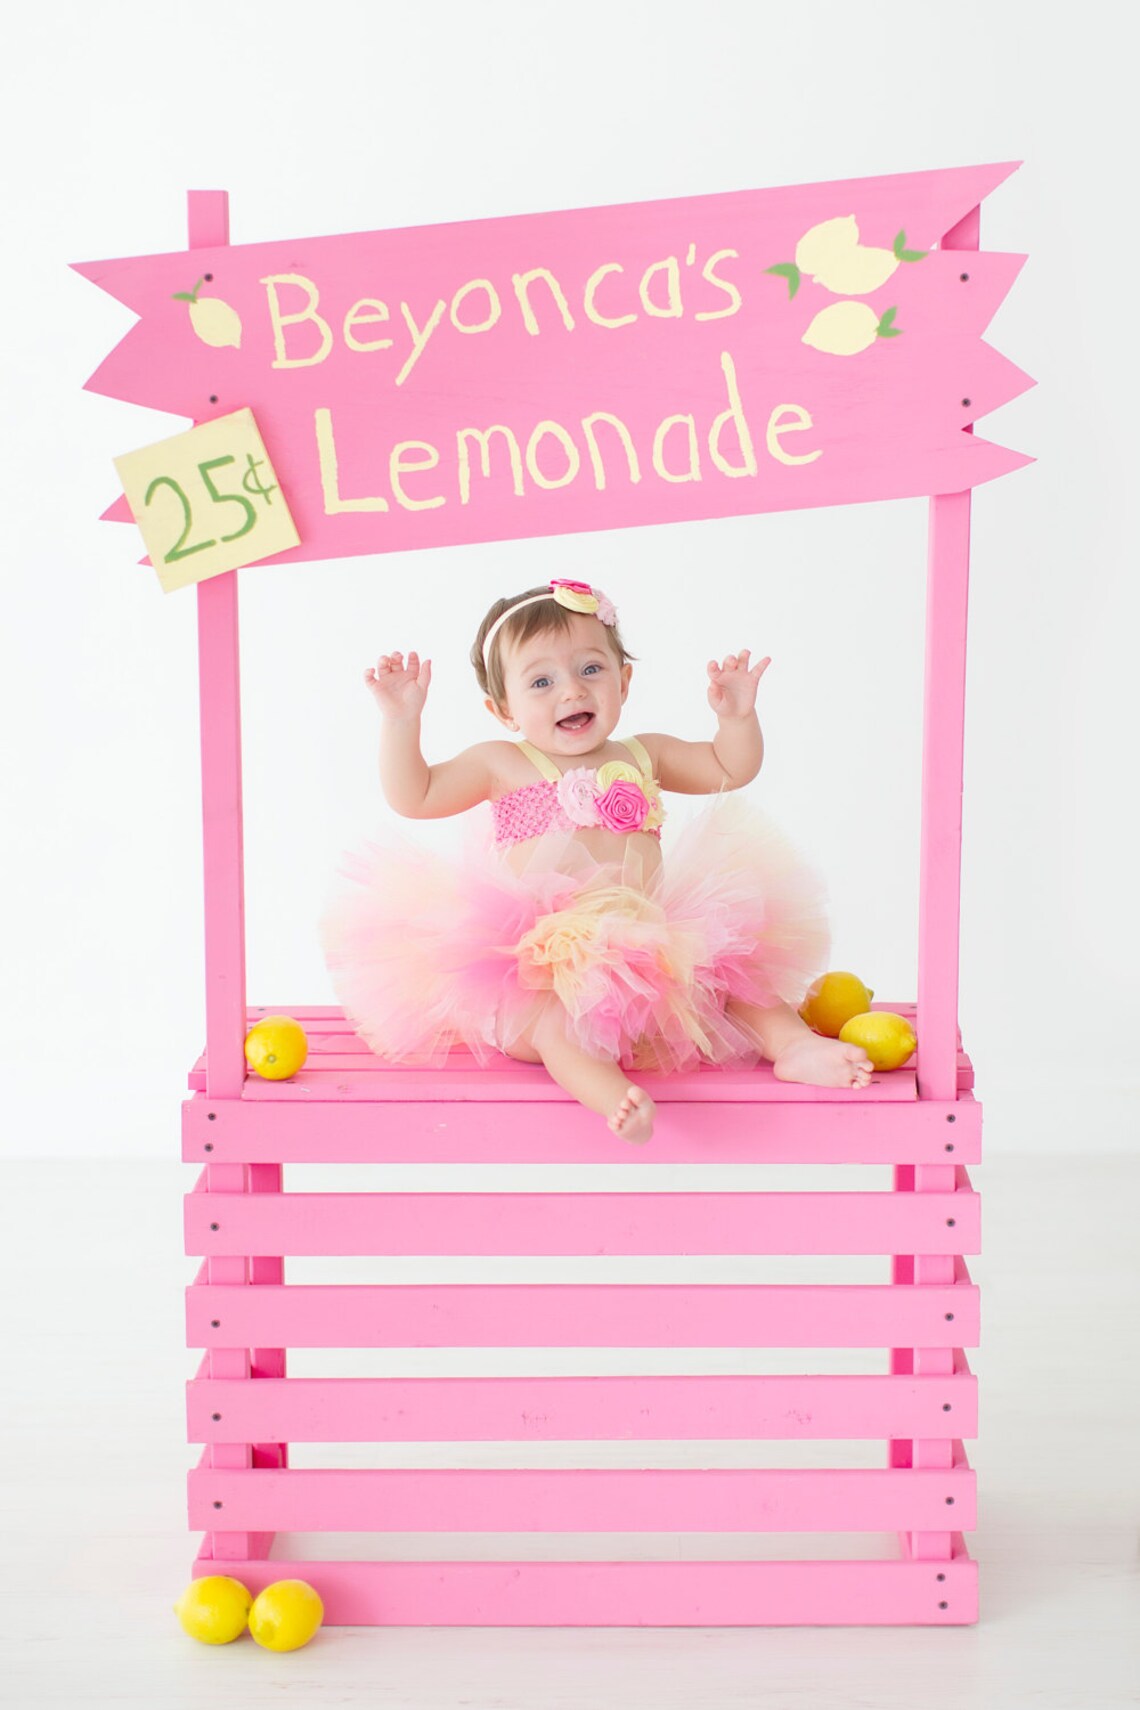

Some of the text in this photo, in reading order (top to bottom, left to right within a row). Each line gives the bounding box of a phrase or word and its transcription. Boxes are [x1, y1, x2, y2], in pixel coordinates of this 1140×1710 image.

[259, 243, 742, 386] Beyonca's
[314, 352, 823, 514] Lemonade
[144, 453, 277, 564] 25¢
